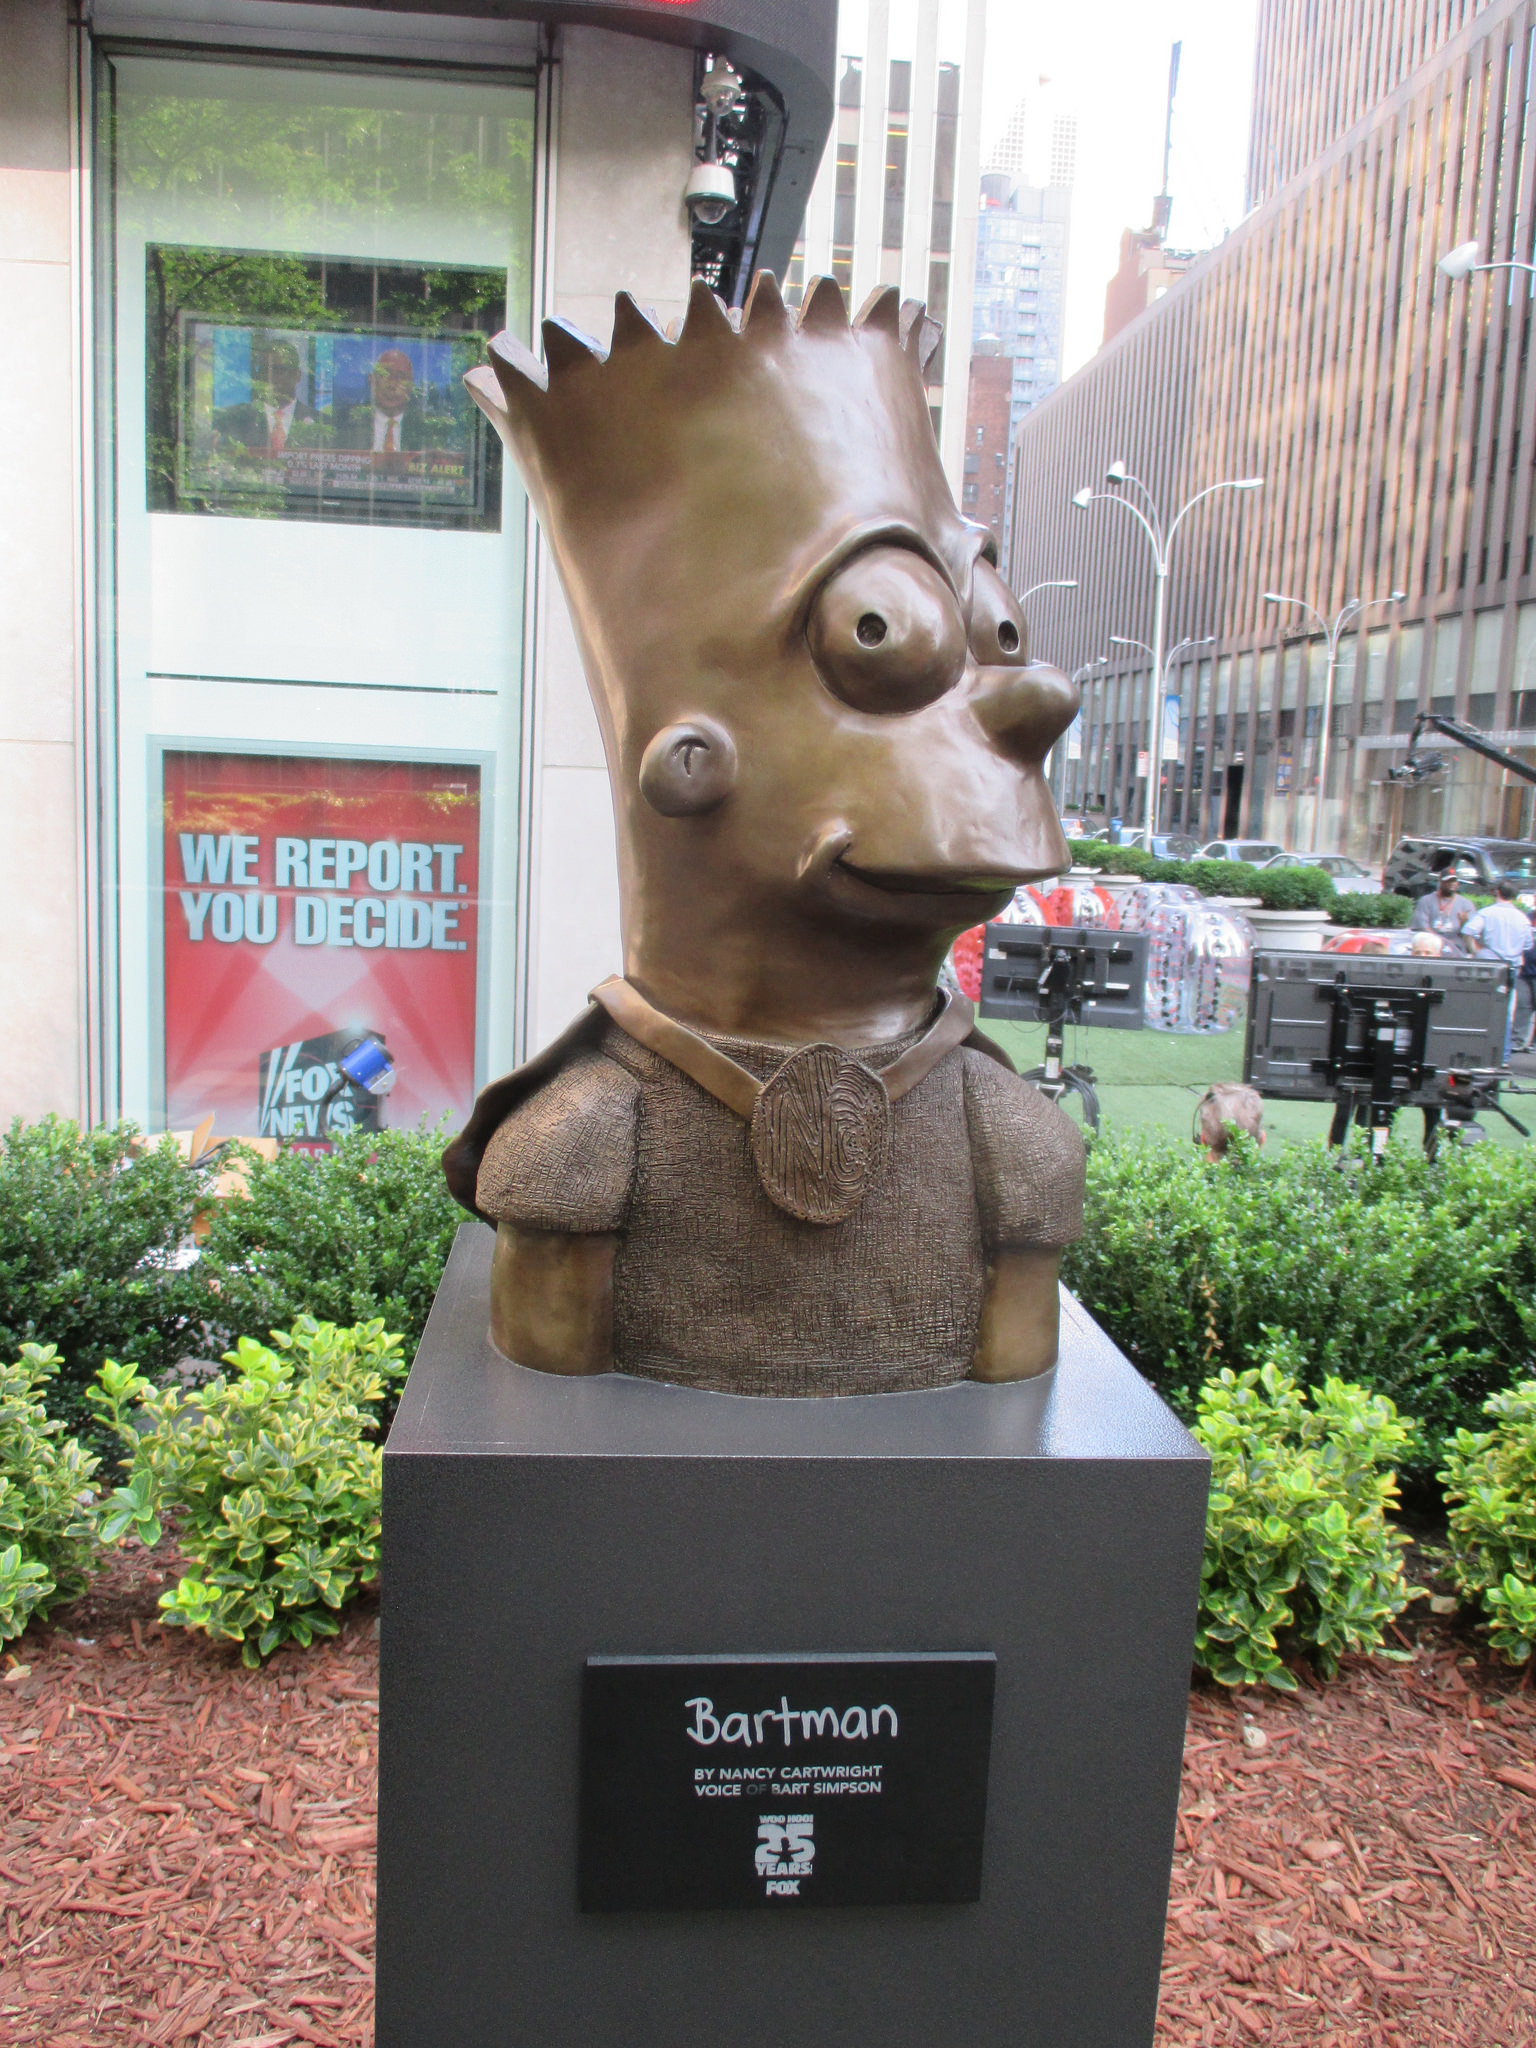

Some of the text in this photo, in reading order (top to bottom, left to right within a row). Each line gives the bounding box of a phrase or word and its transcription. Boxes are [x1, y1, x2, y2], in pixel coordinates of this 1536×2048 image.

[309, 462, 329, 471] LAST
[330, 463, 361, 473] MONTH
[408, 463, 465, 476] BIZ ALERT
[179, 833, 467, 894] WE REPORT.
[179, 891, 277, 944] YOU
[685, 1696, 898, 1747] Bartman
[694, 1765, 882, 1780] BY NANCY CARTWRIGHT
[695, 1781, 882, 1797] VOICE OF BART SIMPSON
[759, 1815, 786, 1824] WOO
[755, 1823, 815, 1863] 25
[755, 1862, 813, 1876] YEARS!
[766, 1880, 800, 1896] FOX
